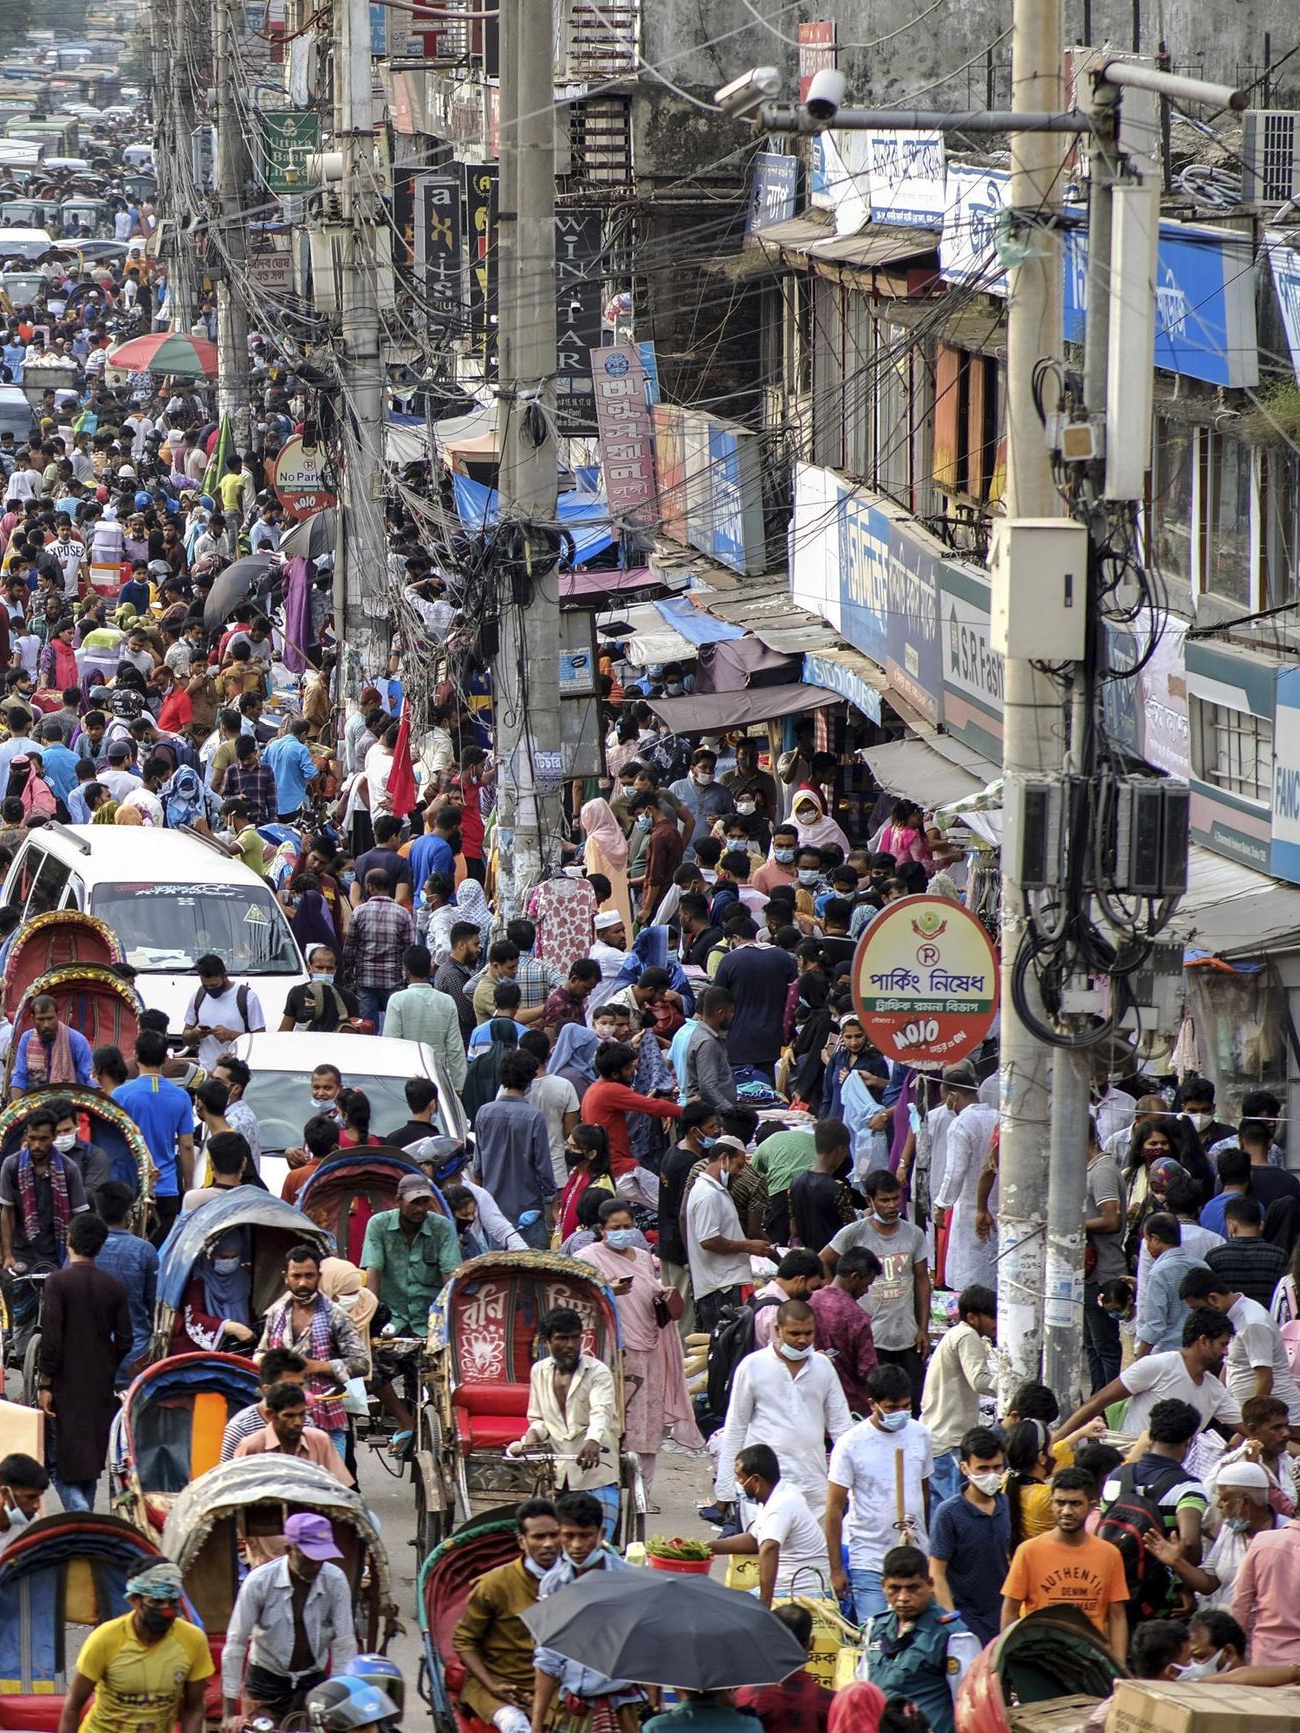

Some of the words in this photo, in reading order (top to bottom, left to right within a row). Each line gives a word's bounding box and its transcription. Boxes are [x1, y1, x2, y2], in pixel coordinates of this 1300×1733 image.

[280, 472, 295, 482] No
[961, 625, 979, 687] S.R
[870, 967, 921, 994] পার্কিং
[929, 968, 985, 993] নিষেধ
[875, 999, 911, 1013] ট্রাফিক
[913, 1001, 944, 1012] রমনা
[946, 999, 980, 1012] বিভাগ
[891, 1018, 940, 1050] MOJO
[1060, 1586, 1088, 1597] DENIM
